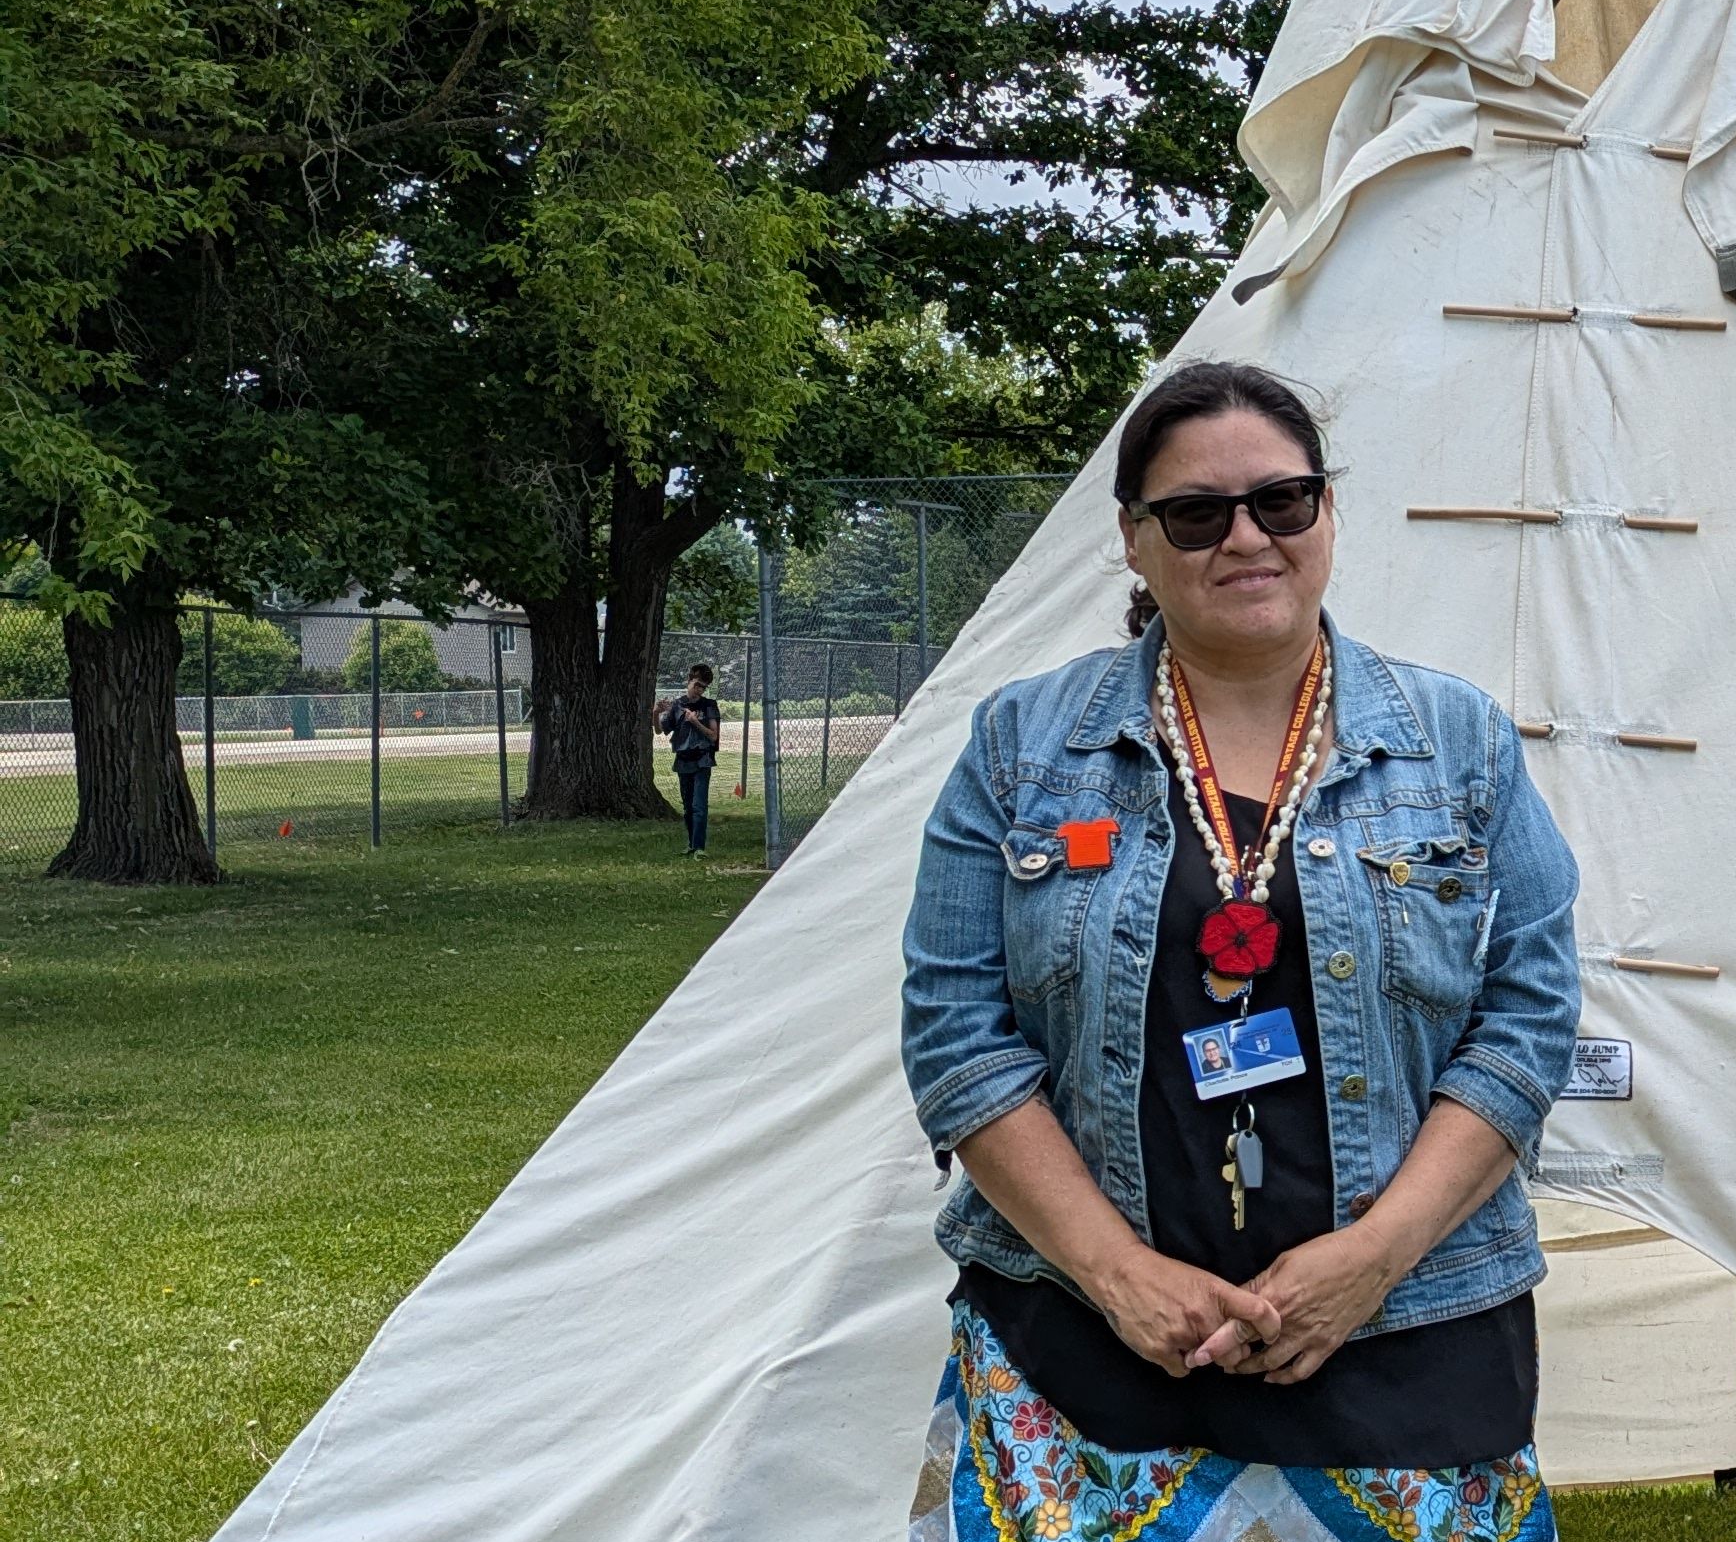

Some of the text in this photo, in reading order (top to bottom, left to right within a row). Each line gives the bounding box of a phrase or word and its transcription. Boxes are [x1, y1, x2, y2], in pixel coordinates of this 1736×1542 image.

[1173, 664, 1193, 719] COLLEGIATE
[1186, 718, 1209, 769] INSTITUTE
[1203, 777, 1224, 820] PORTAGE
[1280, 730, 1300, 772] PORTAGE
[1292, 674, 1317, 729] COLLEGIATE
[1592, 1045, 1619, 1054] JUMP
